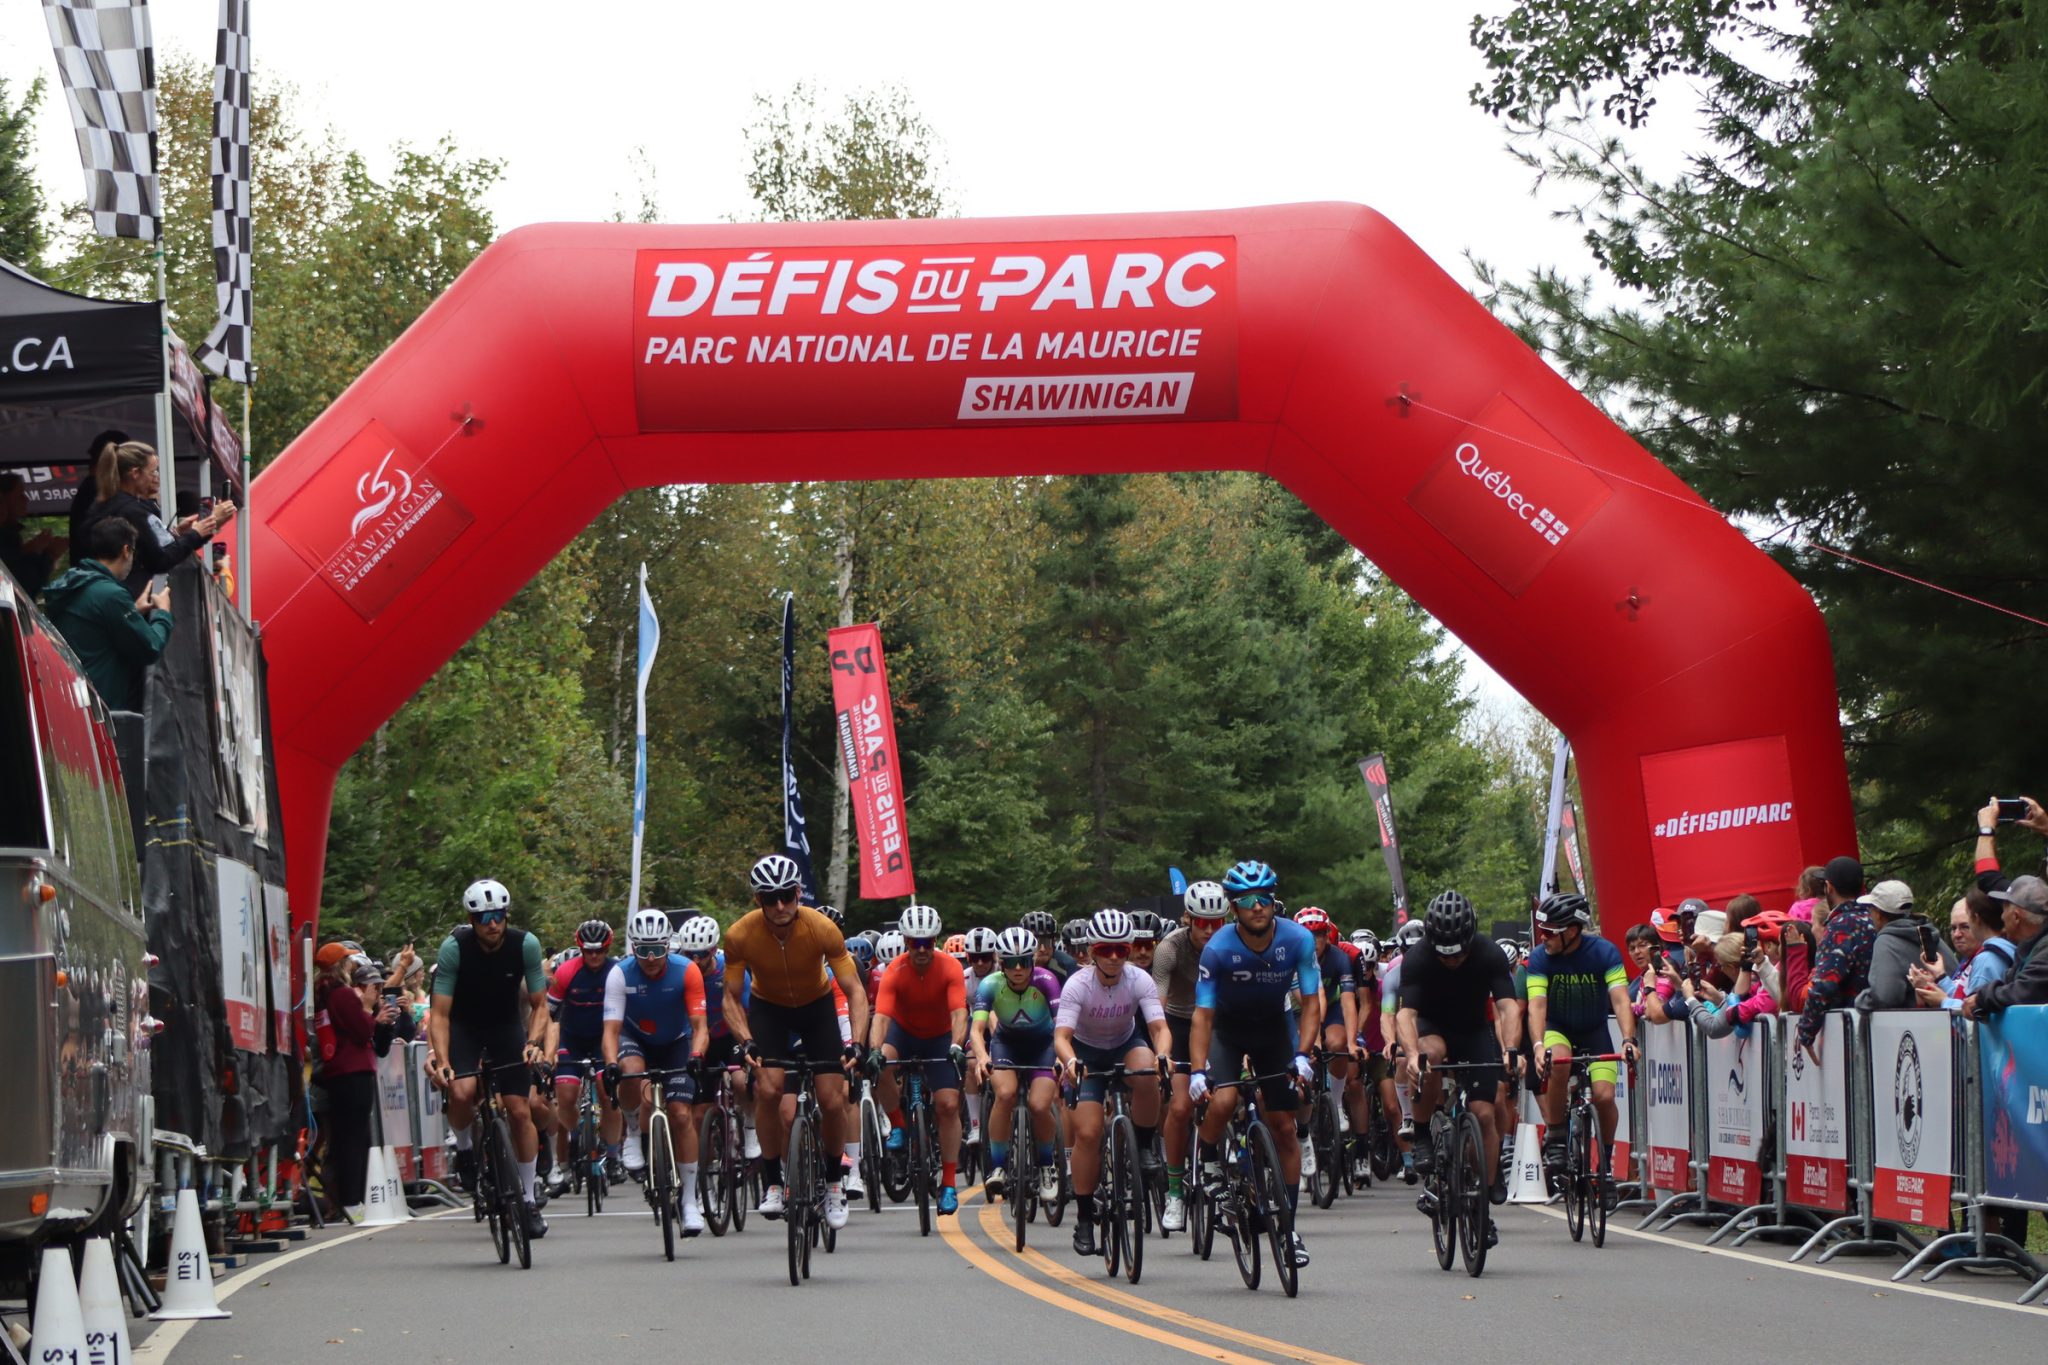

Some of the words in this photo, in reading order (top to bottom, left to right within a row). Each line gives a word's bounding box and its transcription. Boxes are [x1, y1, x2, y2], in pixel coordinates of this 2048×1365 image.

[647, 251, 906, 317] DÉFIS
[910, 268, 970, 301] DU
[977, 250, 1226, 312] PARC
[644, 335, 738, 365] PARC
[746, 333, 915, 364] NATIONAL
[926, 332, 973, 362] DE
[980, 331, 1026, 361] LA
[1036, 327, 1203, 361] MAURICIE
[971, 379, 1183, 413] SHAWINIGAN
[1455, 442, 1535, 521] Québec
[333, 479, 435, 582] SHAWINIGAN
[344, 575, 359, 591] UN
[358, 537, 396, 578] COURANT
[1655, 802, 1792, 838] #DÉFISDUPARC
[1552, 973, 1597, 985] PRIMAL
[1089, 1003, 1131, 1018] shadow
